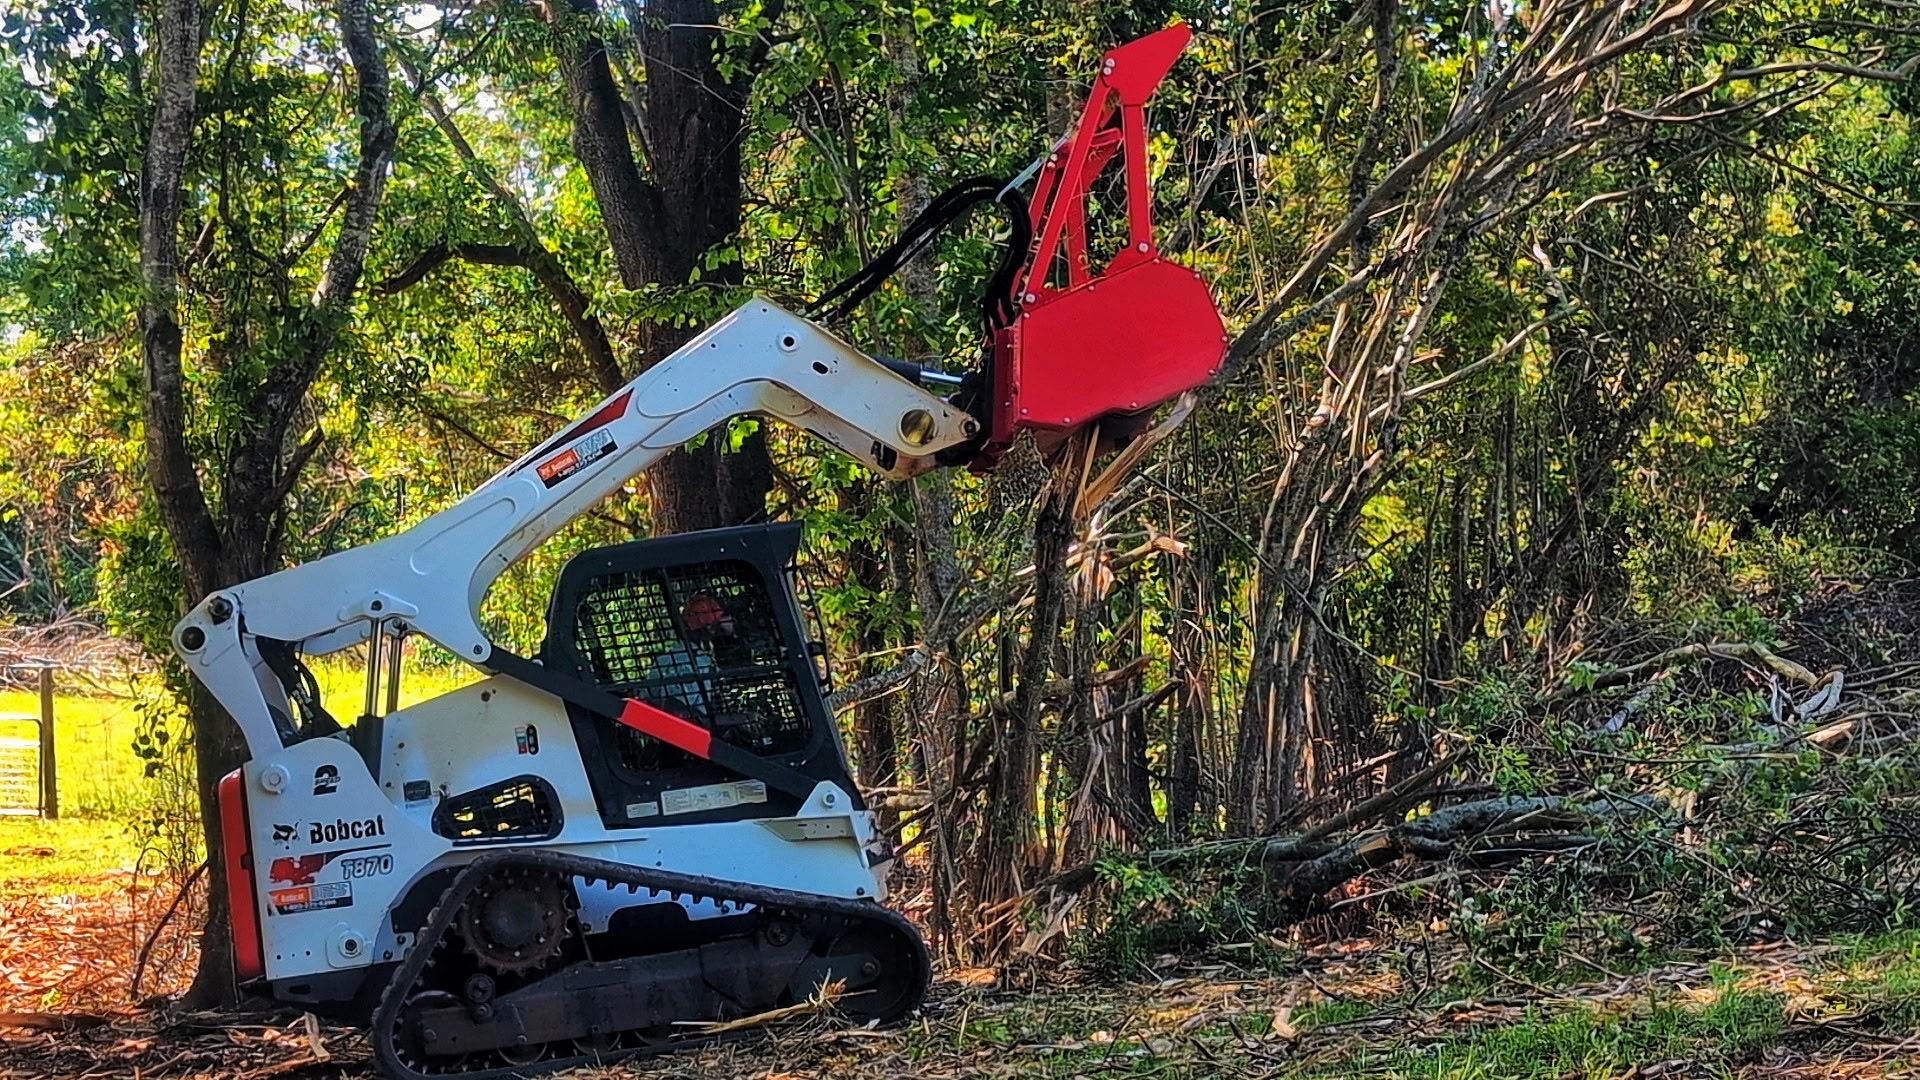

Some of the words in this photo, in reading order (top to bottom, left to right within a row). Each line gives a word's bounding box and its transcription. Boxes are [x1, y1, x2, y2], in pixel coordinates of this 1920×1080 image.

[313, 764, 338, 795] 2
[308, 814, 385, 844] Bobcat
[341, 854, 394, 880] T870
